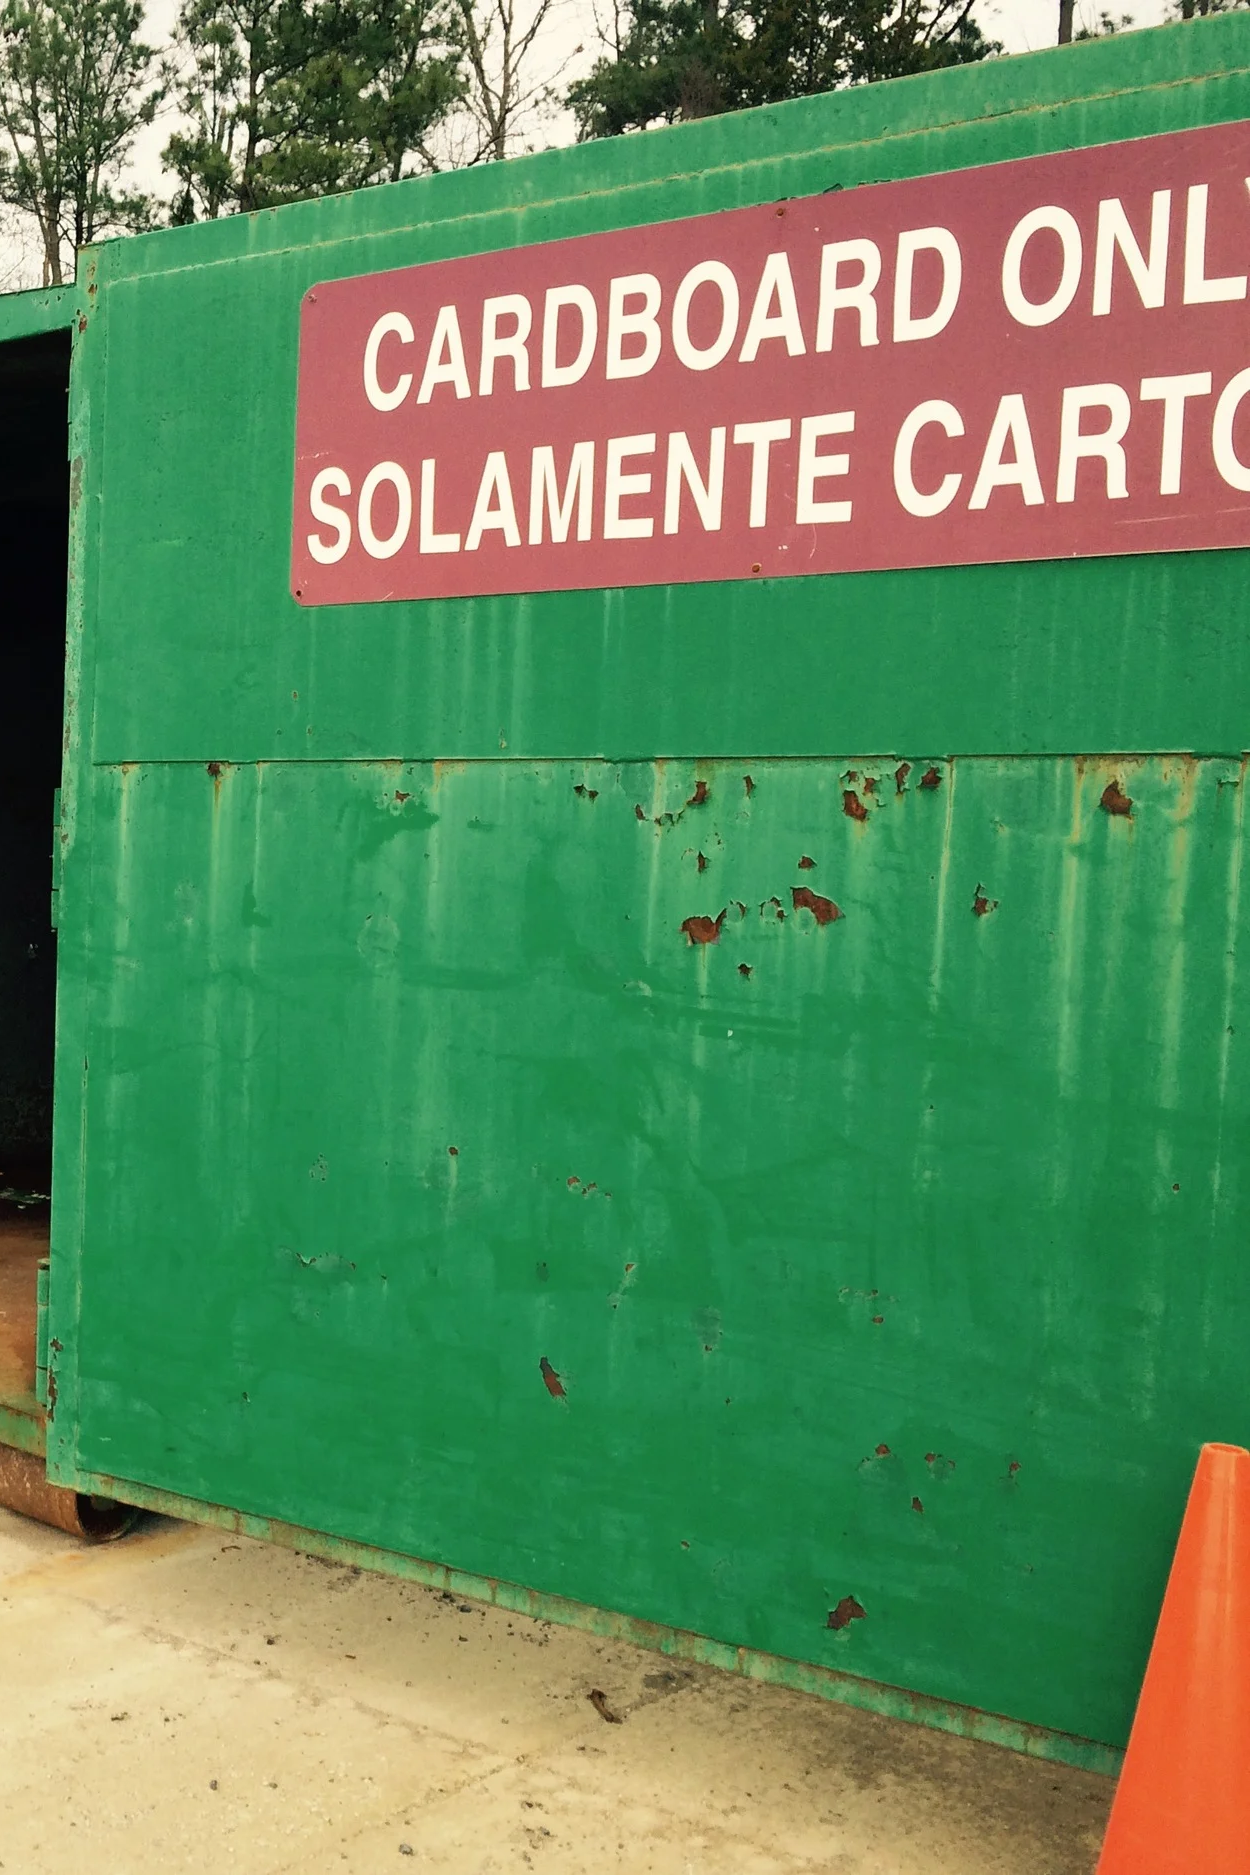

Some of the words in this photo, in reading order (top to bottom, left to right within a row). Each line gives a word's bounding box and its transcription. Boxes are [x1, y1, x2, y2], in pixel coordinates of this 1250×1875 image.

[362, 225, 964, 413] CARDBOARD
[1000, 177, 1250, 328] ONL
[306, 410, 856, 565] SOLAMENTE
